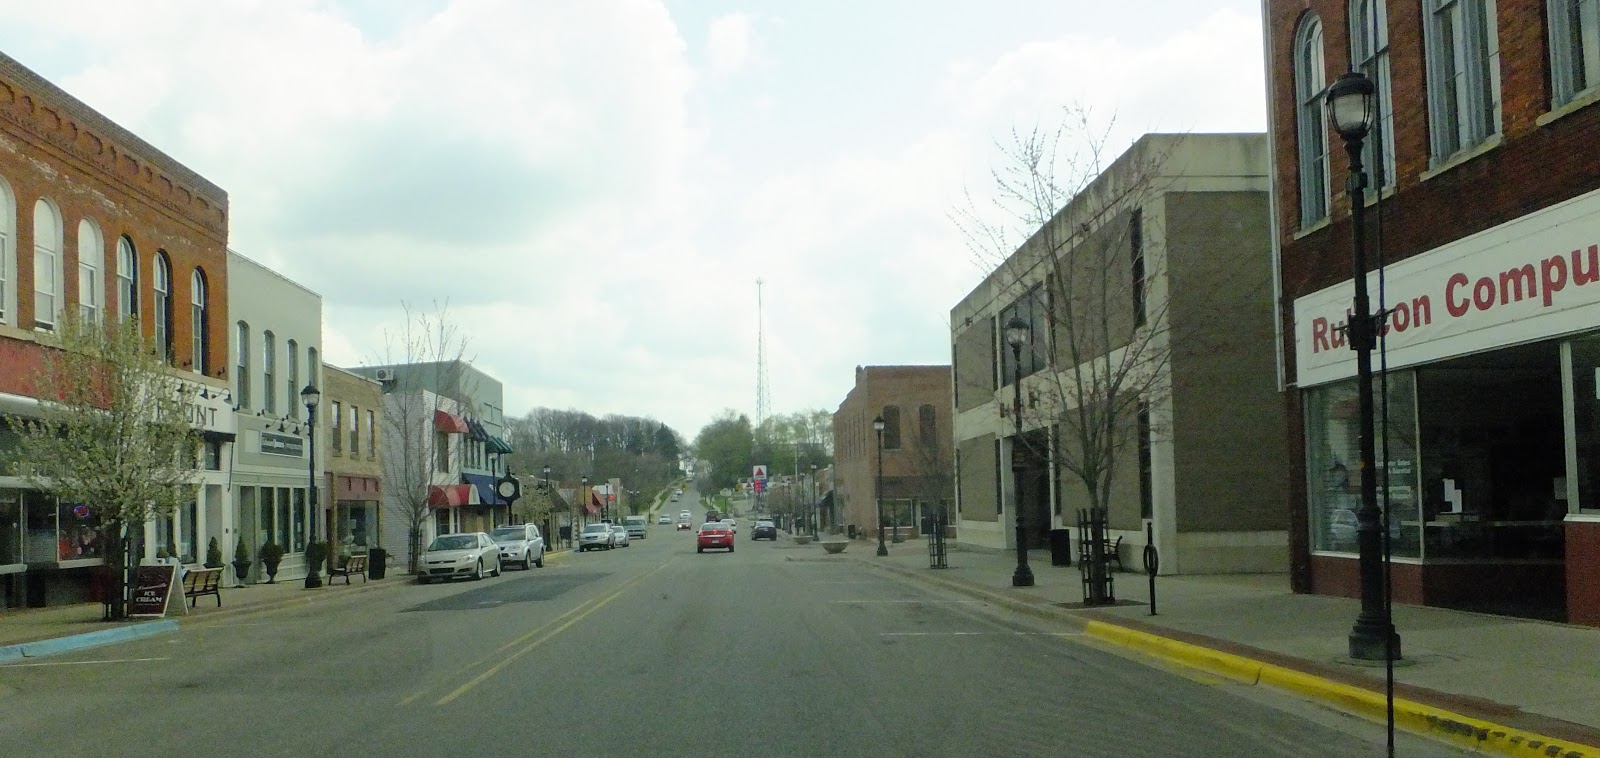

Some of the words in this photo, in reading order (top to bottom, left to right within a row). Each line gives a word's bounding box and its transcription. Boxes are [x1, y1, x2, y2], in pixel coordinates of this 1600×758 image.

[1312, 294, 1432, 353] Rucon
[1445, 244, 1600, 318] Compu
[156, 397, 218, 427] FONT
